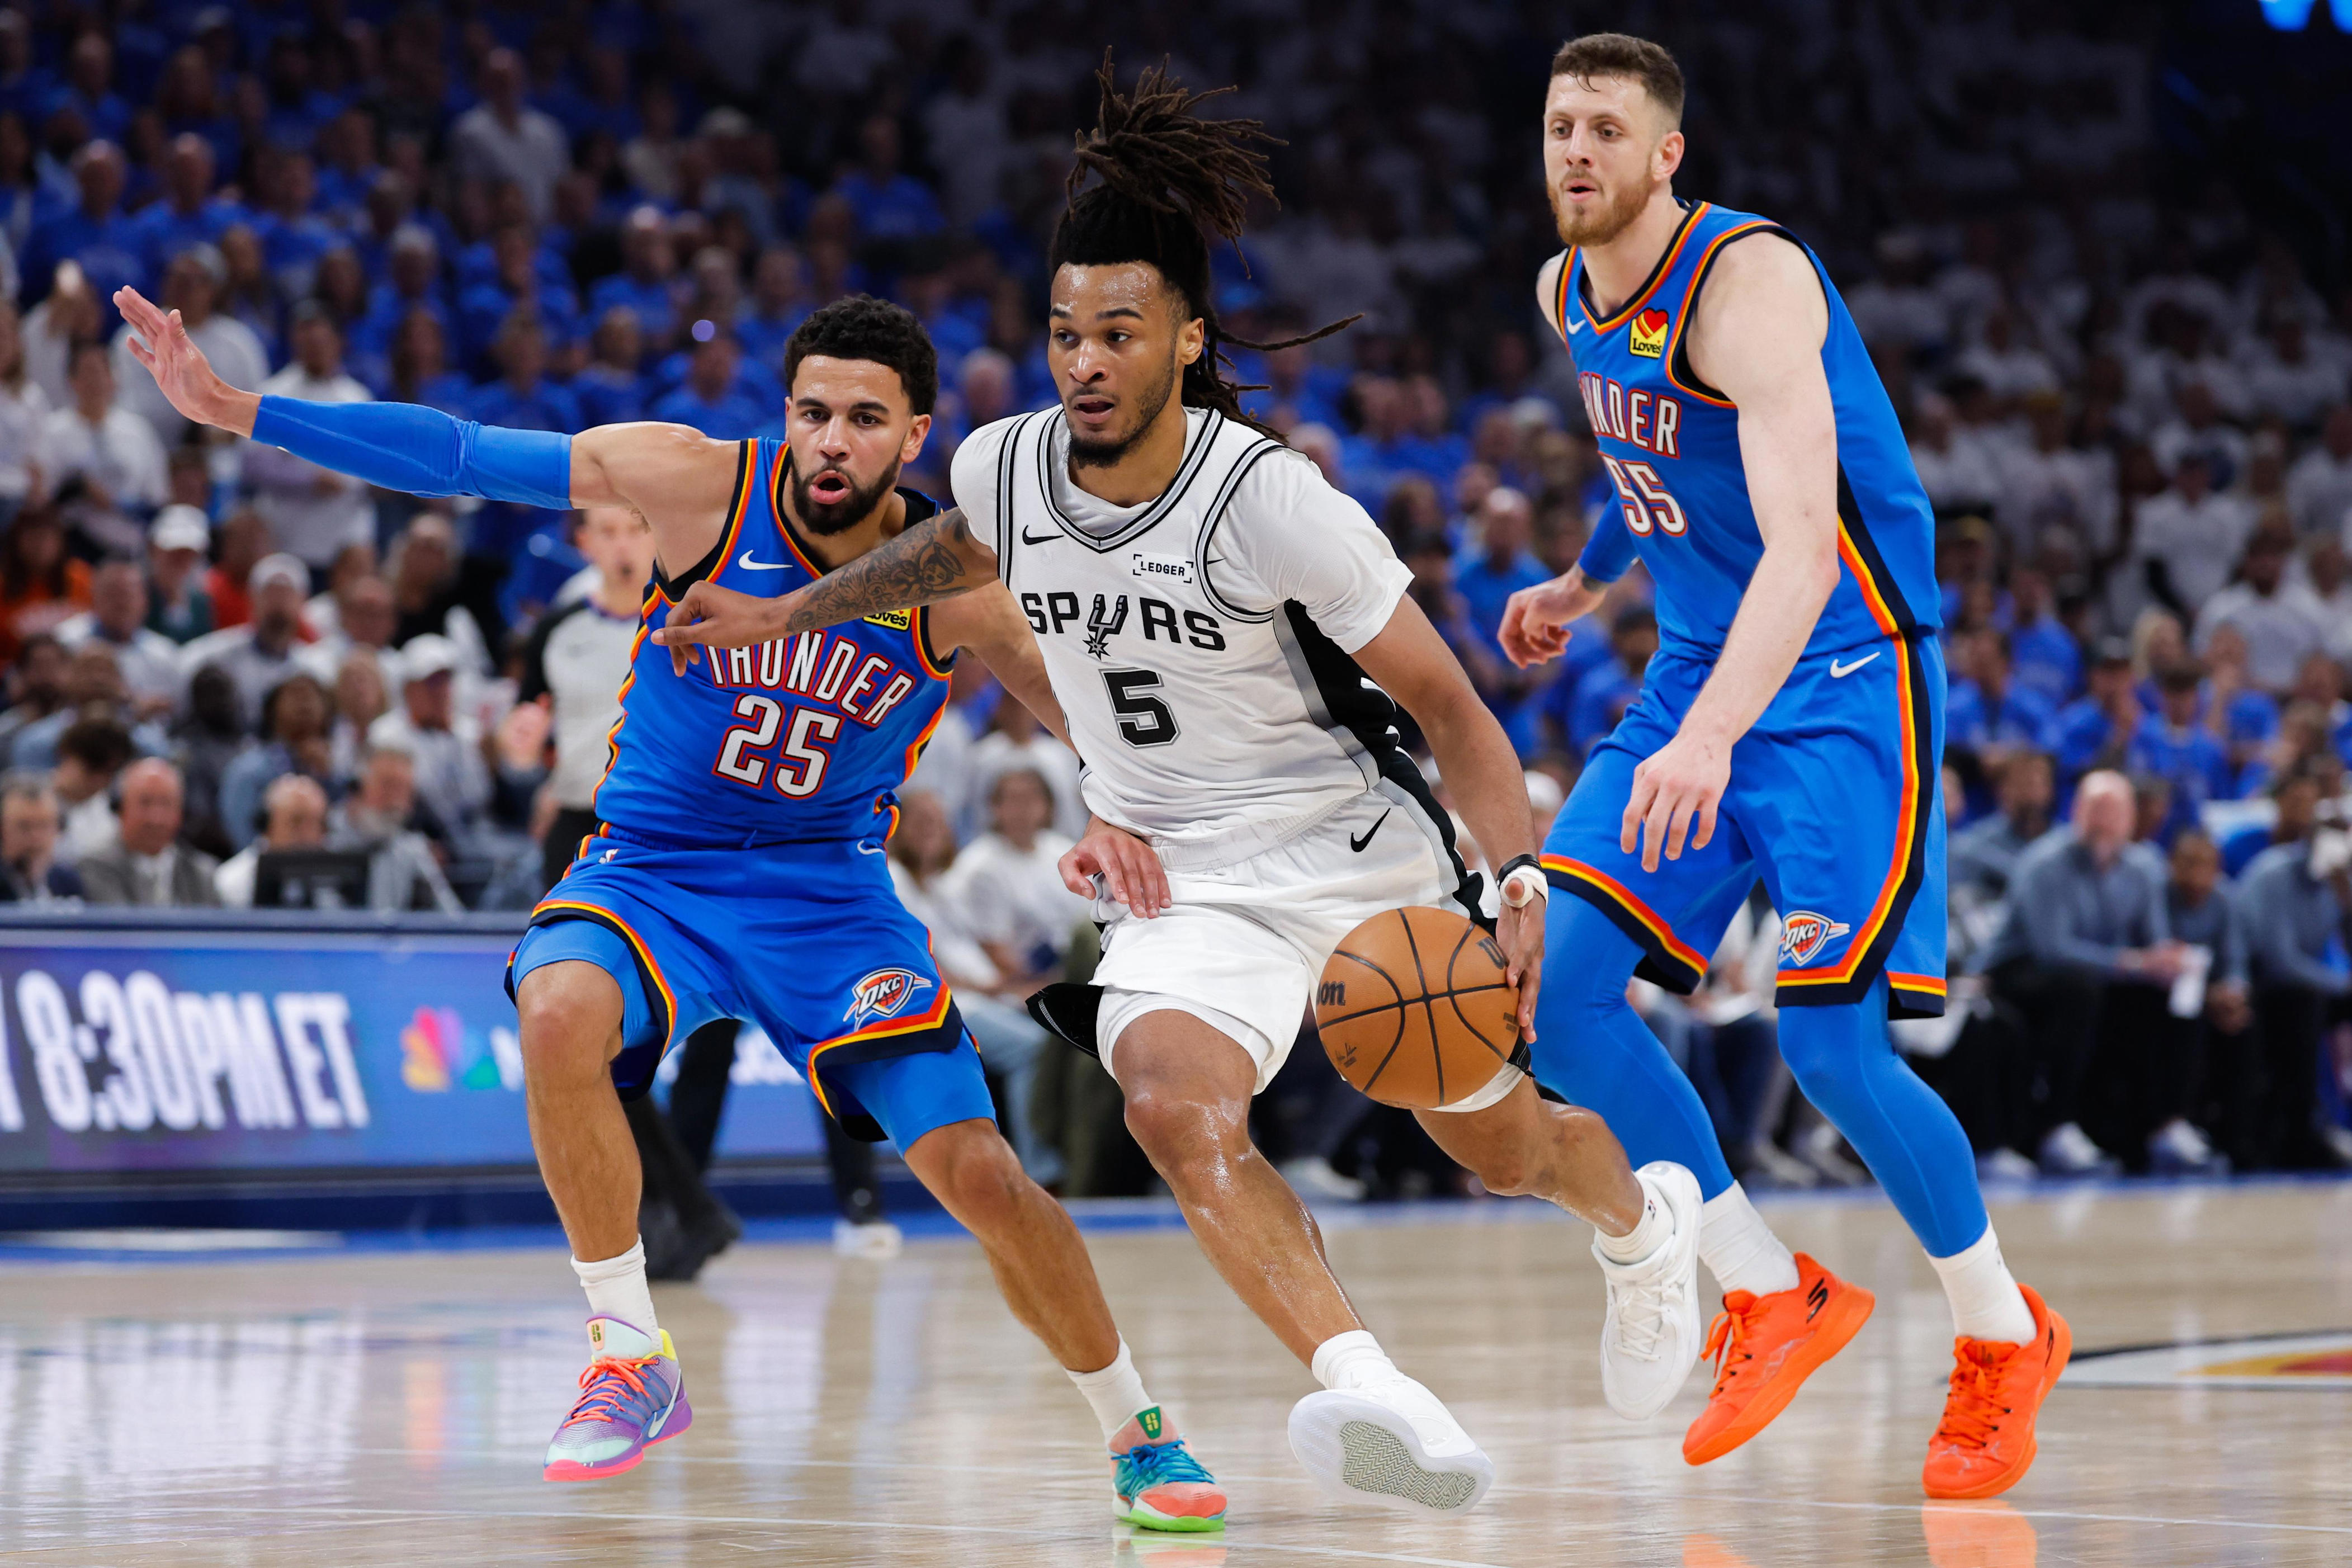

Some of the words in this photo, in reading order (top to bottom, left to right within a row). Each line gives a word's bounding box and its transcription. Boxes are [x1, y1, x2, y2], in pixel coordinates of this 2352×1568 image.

[1598, 450, 1688, 537] 55
[1140, 560, 1185, 577] LEDGER
[1021, 591, 1226, 660] SPURS
[1098, 667, 1181, 749] 5
[711, 692, 846, 800] 25
[1783, 923, 1817, 953] OKC
[857, 976, 901, 1017] OKC
